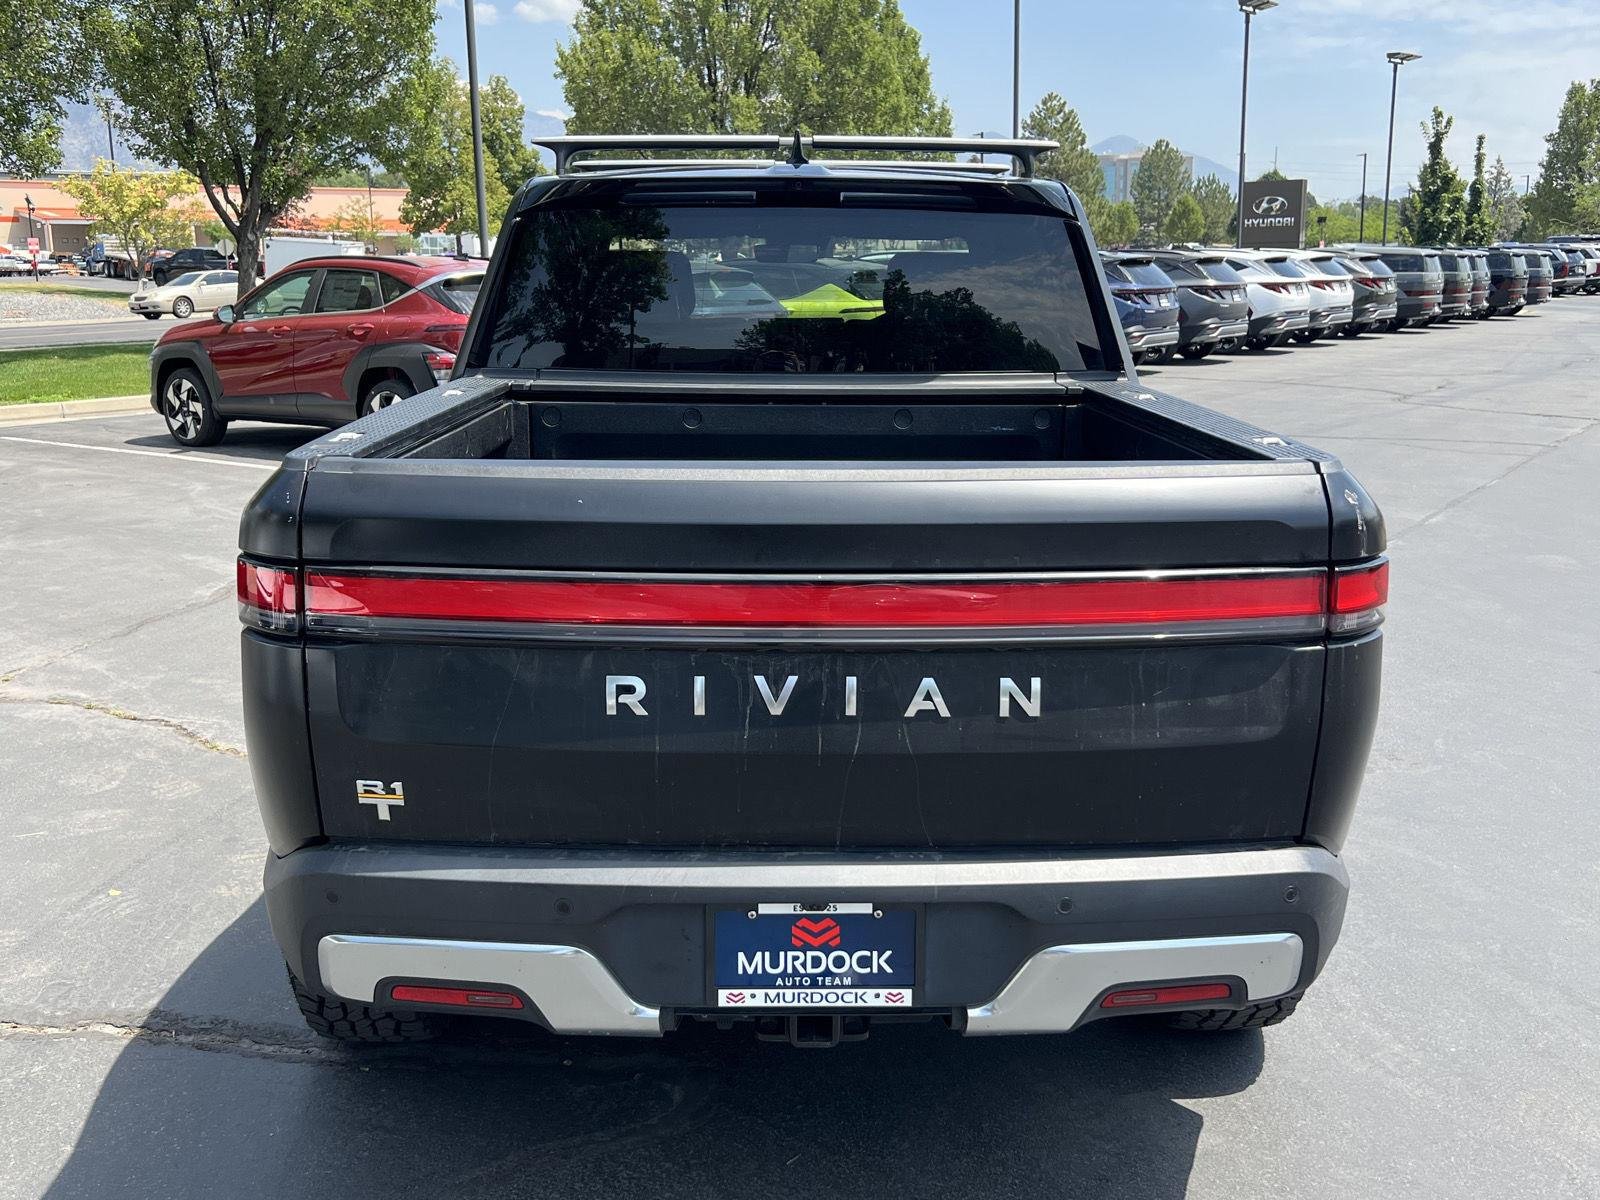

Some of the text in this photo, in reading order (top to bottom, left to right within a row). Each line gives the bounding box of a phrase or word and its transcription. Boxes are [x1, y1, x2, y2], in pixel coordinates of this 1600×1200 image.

[1244, 217, 1295, 228] HYUNDAI
[605, 675, 1042, 718] RIVIAN
[737, 950, 894, 974] MURDOCK
[775, 977, 852, 986] AUTO TEAM
[764, 991, 869, 1004] MURDOCK
